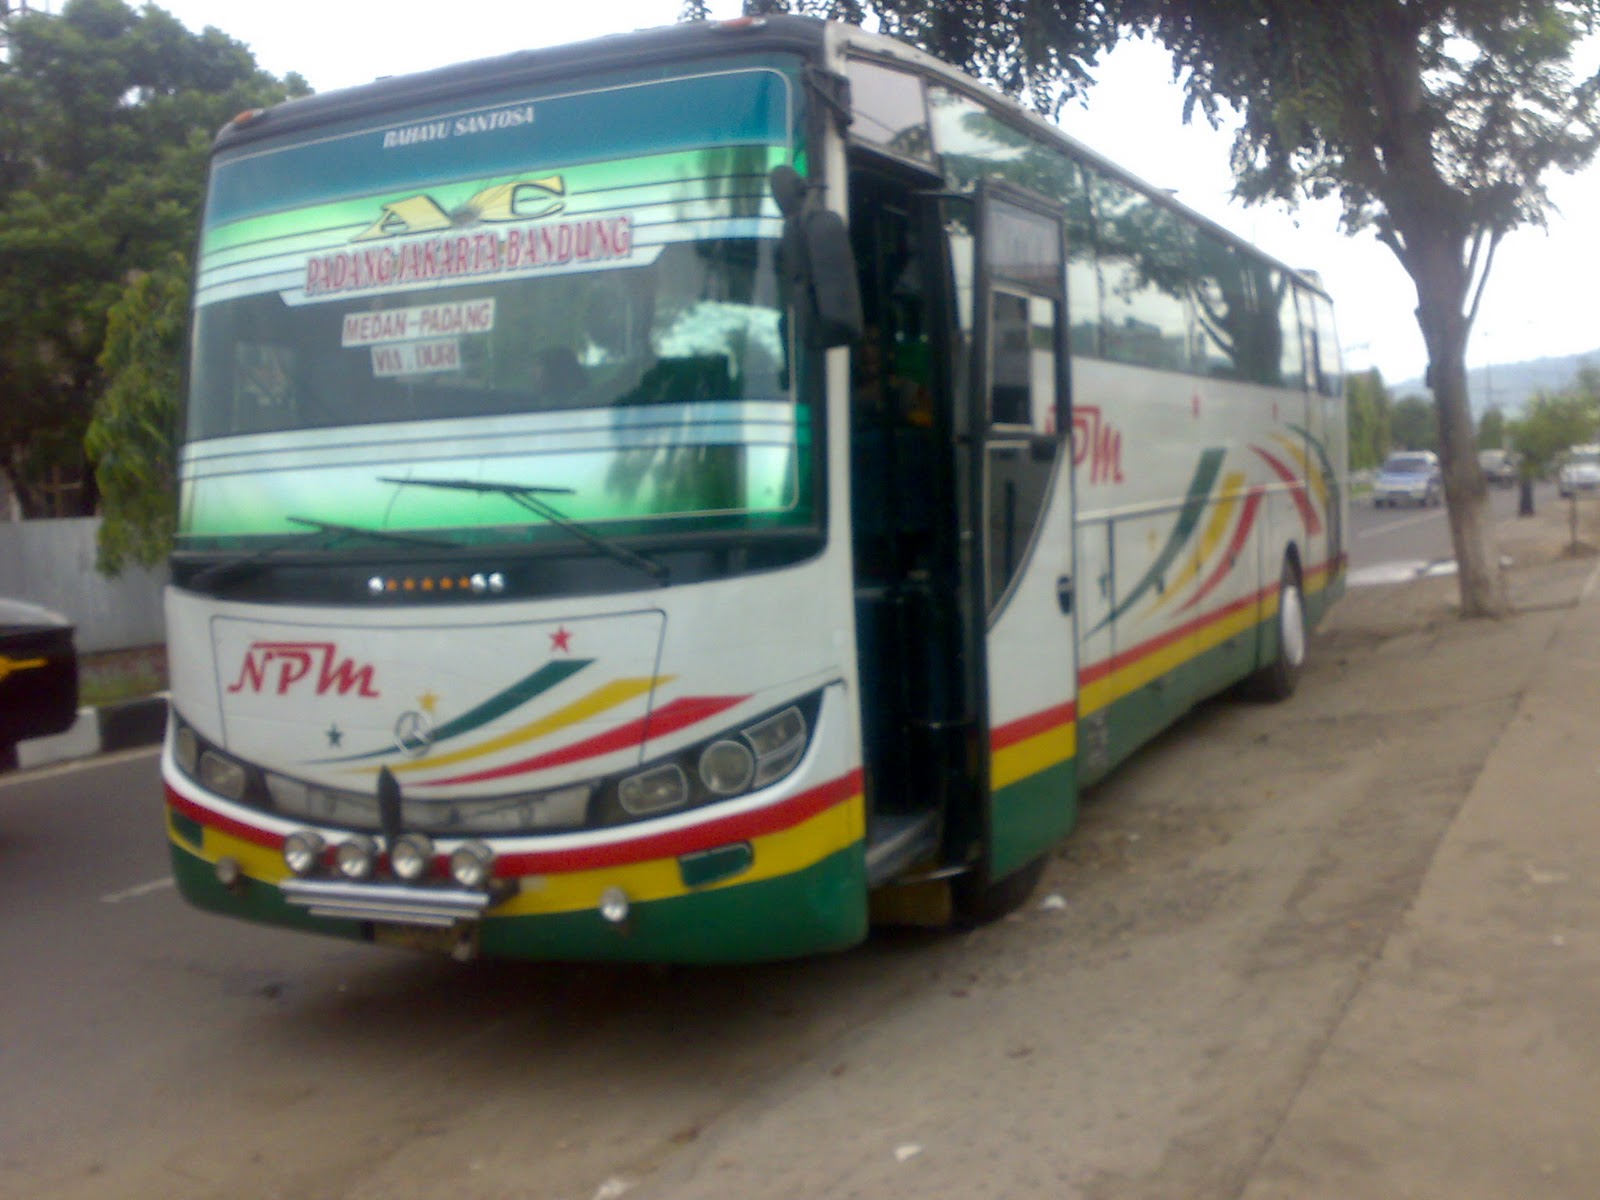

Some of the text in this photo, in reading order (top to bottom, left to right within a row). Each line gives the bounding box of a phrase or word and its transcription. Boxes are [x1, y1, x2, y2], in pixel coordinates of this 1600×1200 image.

[383, 106, 534, 149] RAHAYU SANTOSA
[507, 216, 632, 268] BANDUNG
